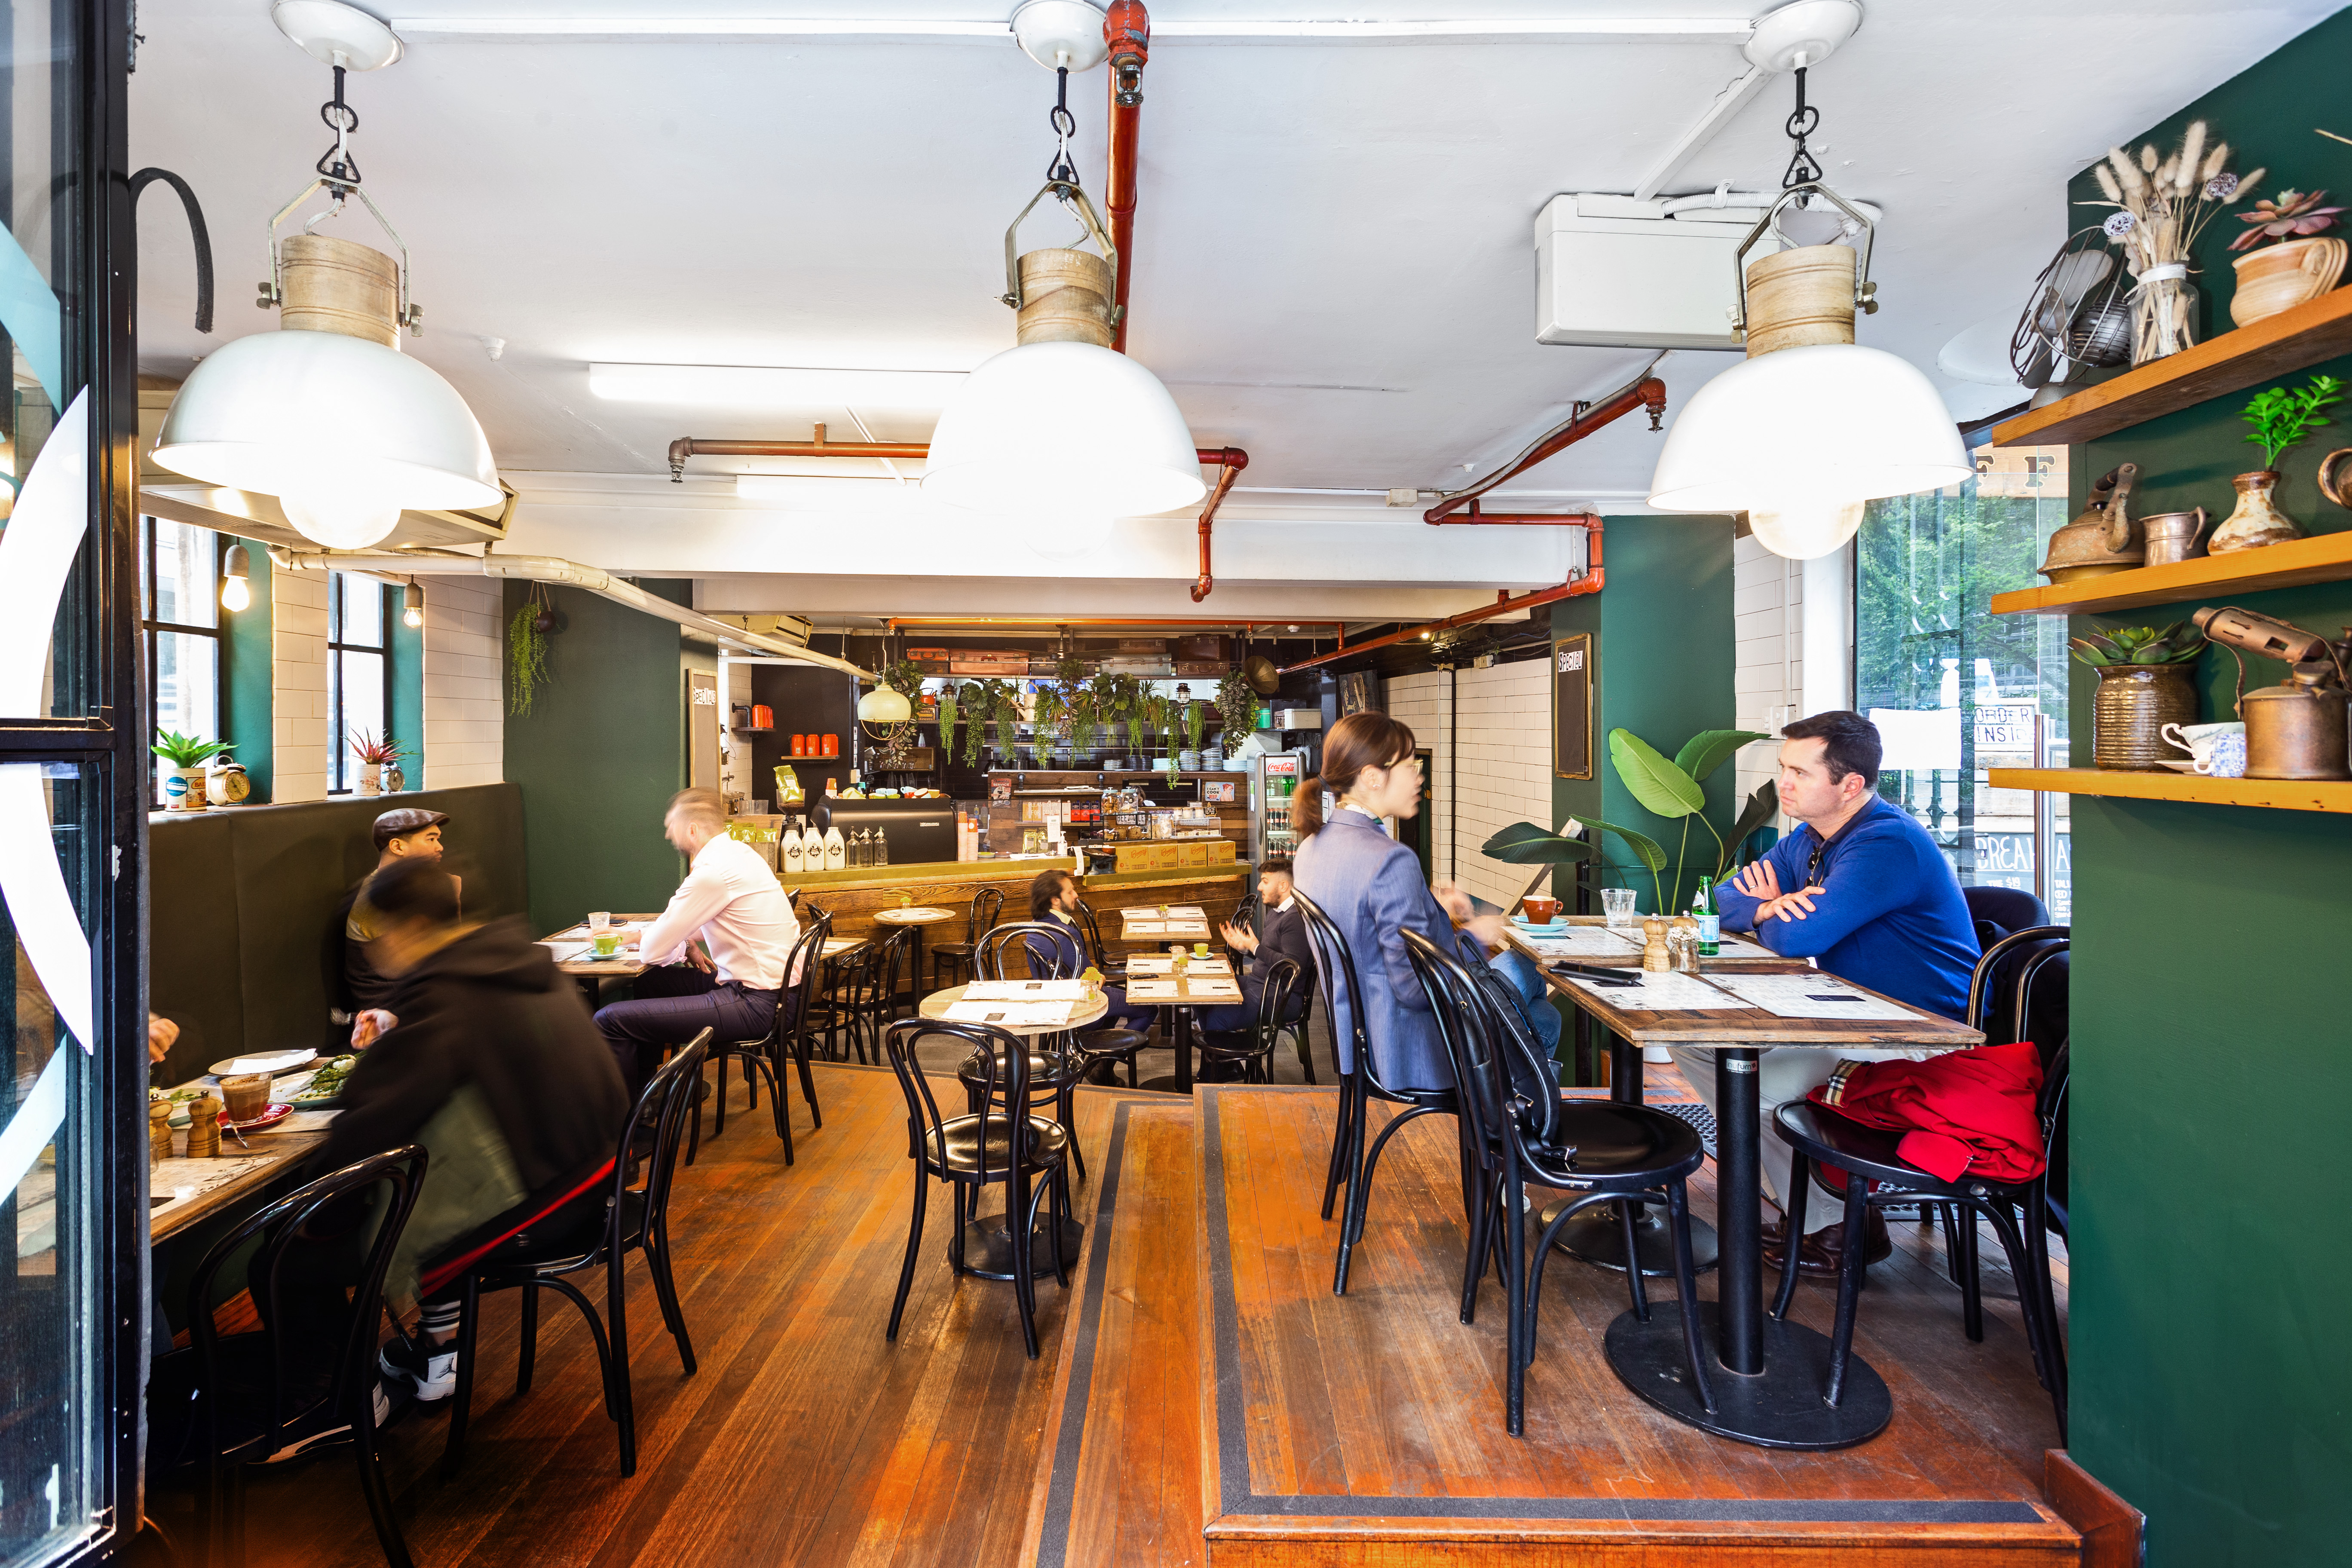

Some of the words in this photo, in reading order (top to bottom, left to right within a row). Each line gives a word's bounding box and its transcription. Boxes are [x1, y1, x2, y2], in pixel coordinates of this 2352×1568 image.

[693, 688, 715, 704] SPECIALS
[1975, 707, 2030, 723] ORDER
[1268, 762, 1295, 772] Coca-Cola
